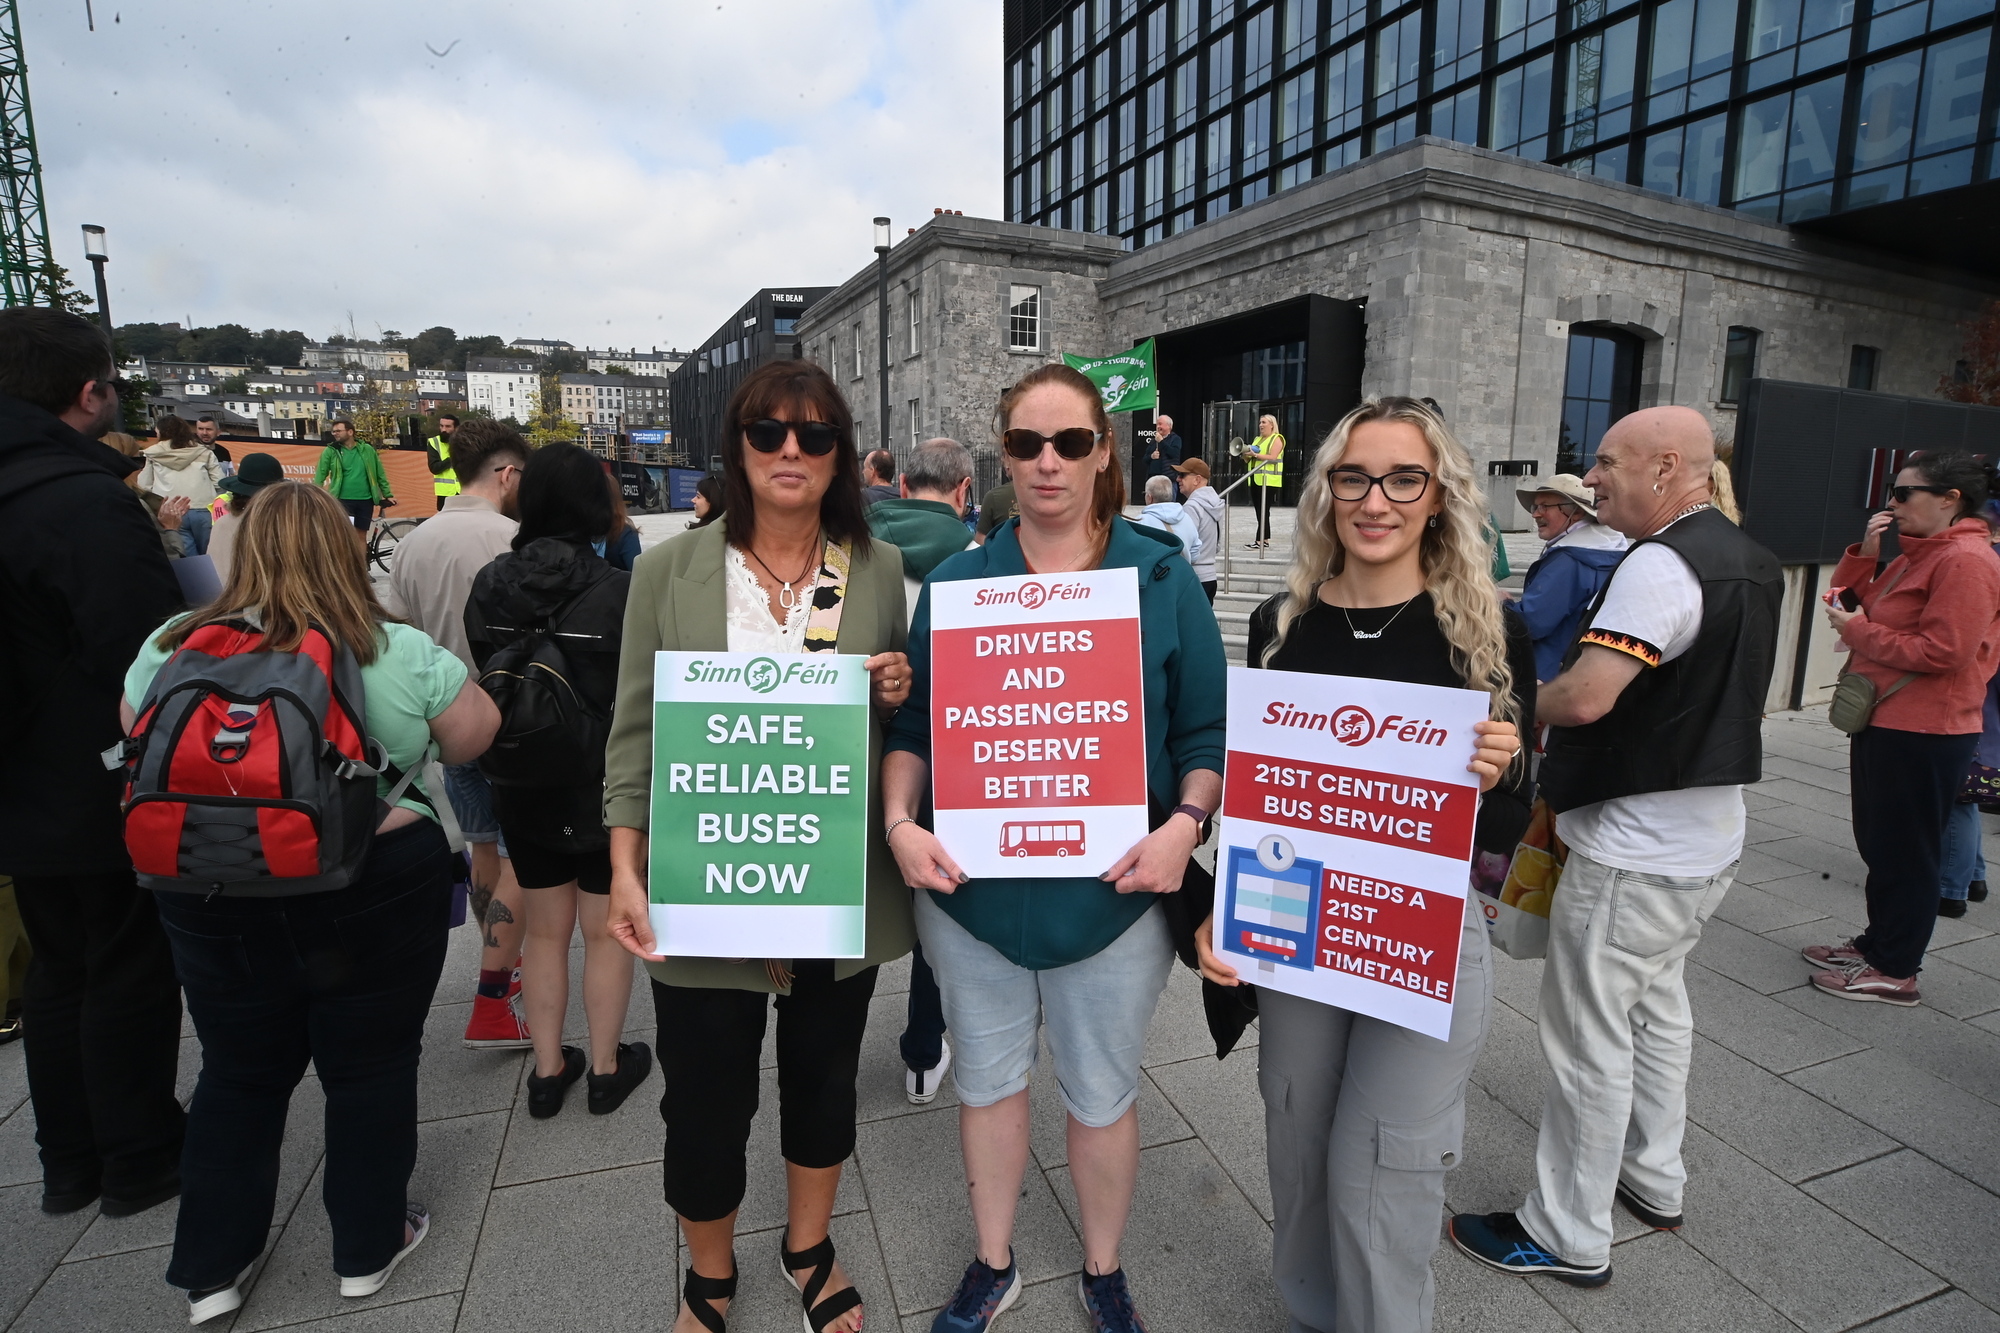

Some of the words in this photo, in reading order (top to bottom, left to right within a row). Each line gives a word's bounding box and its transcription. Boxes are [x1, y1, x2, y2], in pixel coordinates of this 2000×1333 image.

[772, 294, 784, 302] THE
[974, 588, 1016, 606] Sinn
[1047, 582, 1091, 601] Féin
[975, 629, 1094, 657] DRIVERS
[684, 660, 741, 683] Sinn
[782, 662, 839, 685] Féin
[1002, 666, 1066, 691] AND
[945, 699, 1129, 729] PASSENGERS
[1262, 701, 1328, 731] Sinn
[1375, 715, 1448, 747] Féin
[705, 713, 815, 750] SAFE,
[973, 737, 1100, 763] DESERVE
[669, 762, 850, 795] RELIABLE
[984, 774, 1091, 800] BETTER
[1254, 763, 1312, 789] 21ST
[1317, 773, 1449, 812] CENTURY
[697, 812, 821, 844] BUSES
[1263, 795, 1313, 821] BUS
[1318, 804, 1433, 843] SERVICE
[705, 863, 810, 894] NOW
[1329, 872, 1405, 904] NEEDS
[1408, 891, 1427, 911] A
[1326, 899, 1378, 924] 21ST
[1324, 924, 1435, 966] CENTURY
[1322, 948, 1449, 1000] TIMETABLE
